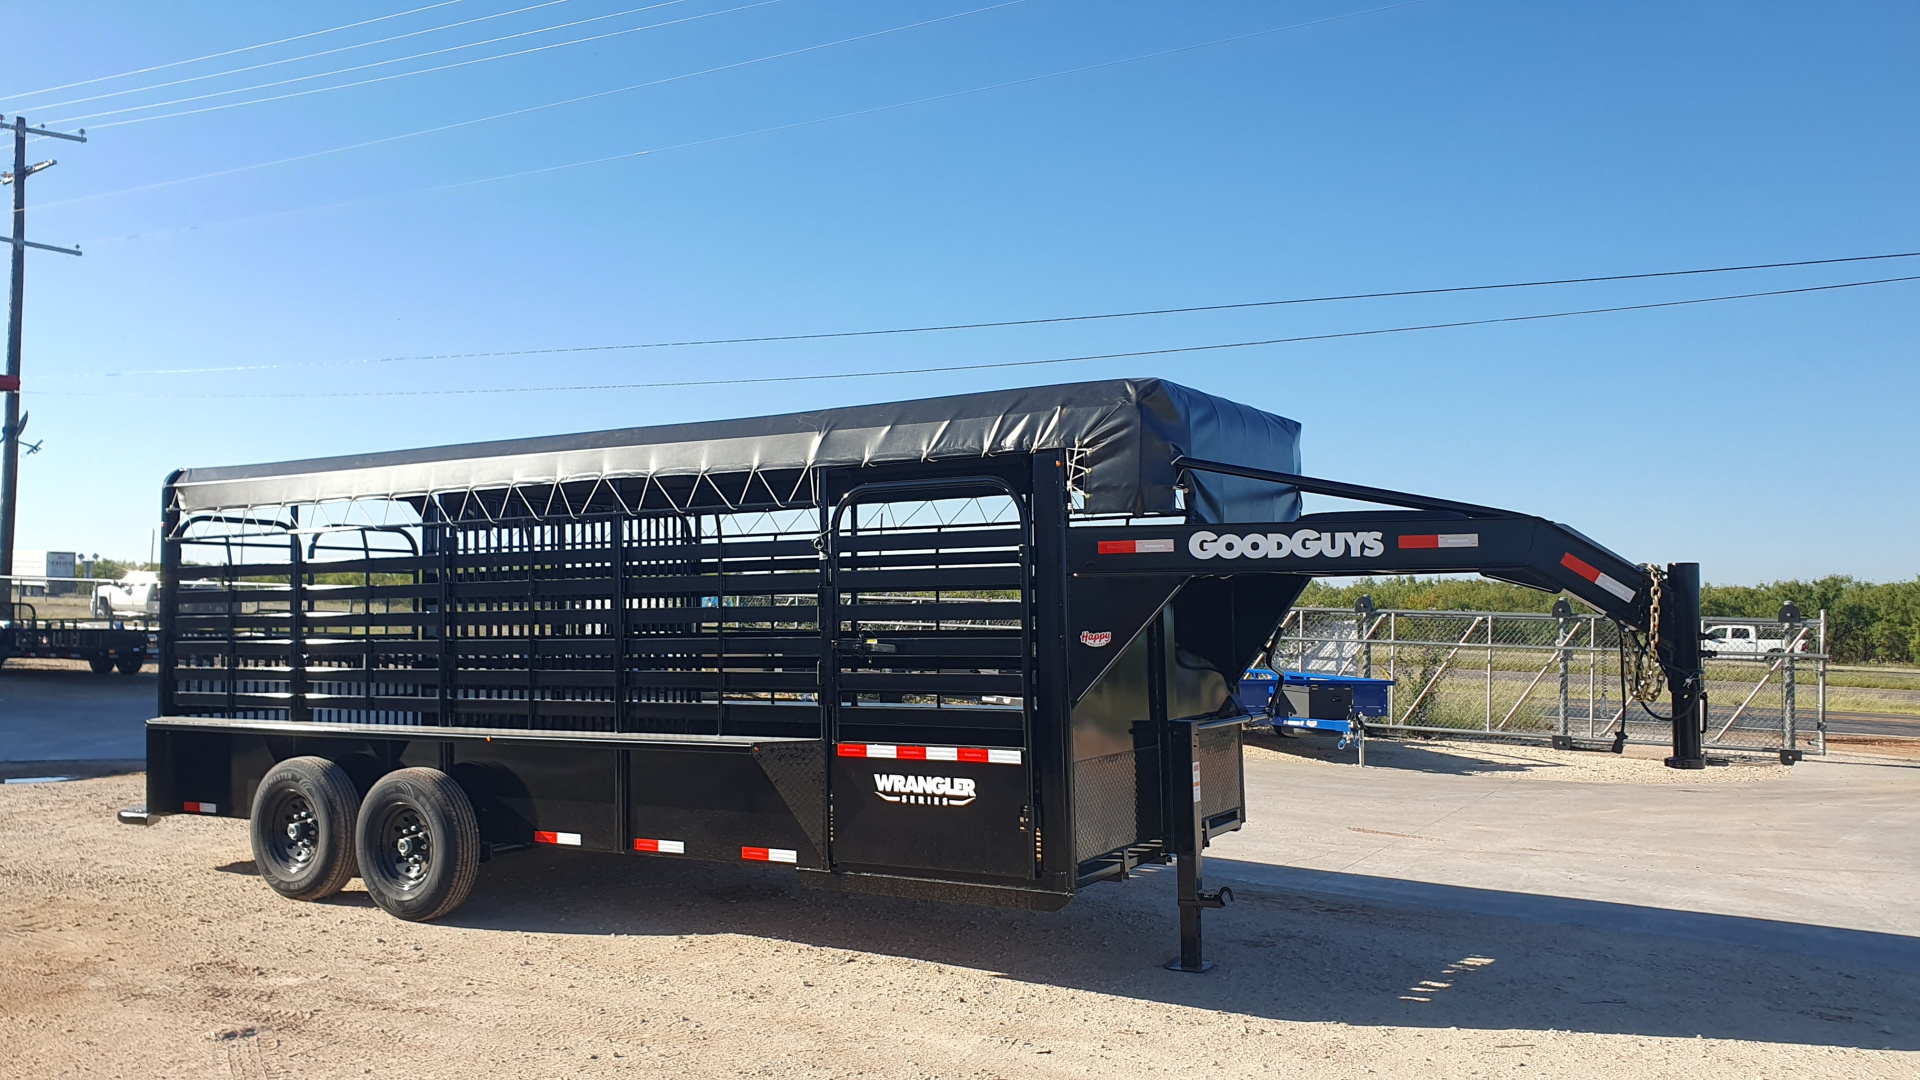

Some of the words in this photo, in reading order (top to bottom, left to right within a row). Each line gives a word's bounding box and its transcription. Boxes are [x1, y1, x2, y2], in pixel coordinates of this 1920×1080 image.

[1188, 529, 1385, 560] GOODGUYS
[1081, 631, 1111, 643] Happy
[873, 773, 977, 797] WRANGLER
[901, 794, 948, 806] SERIES
